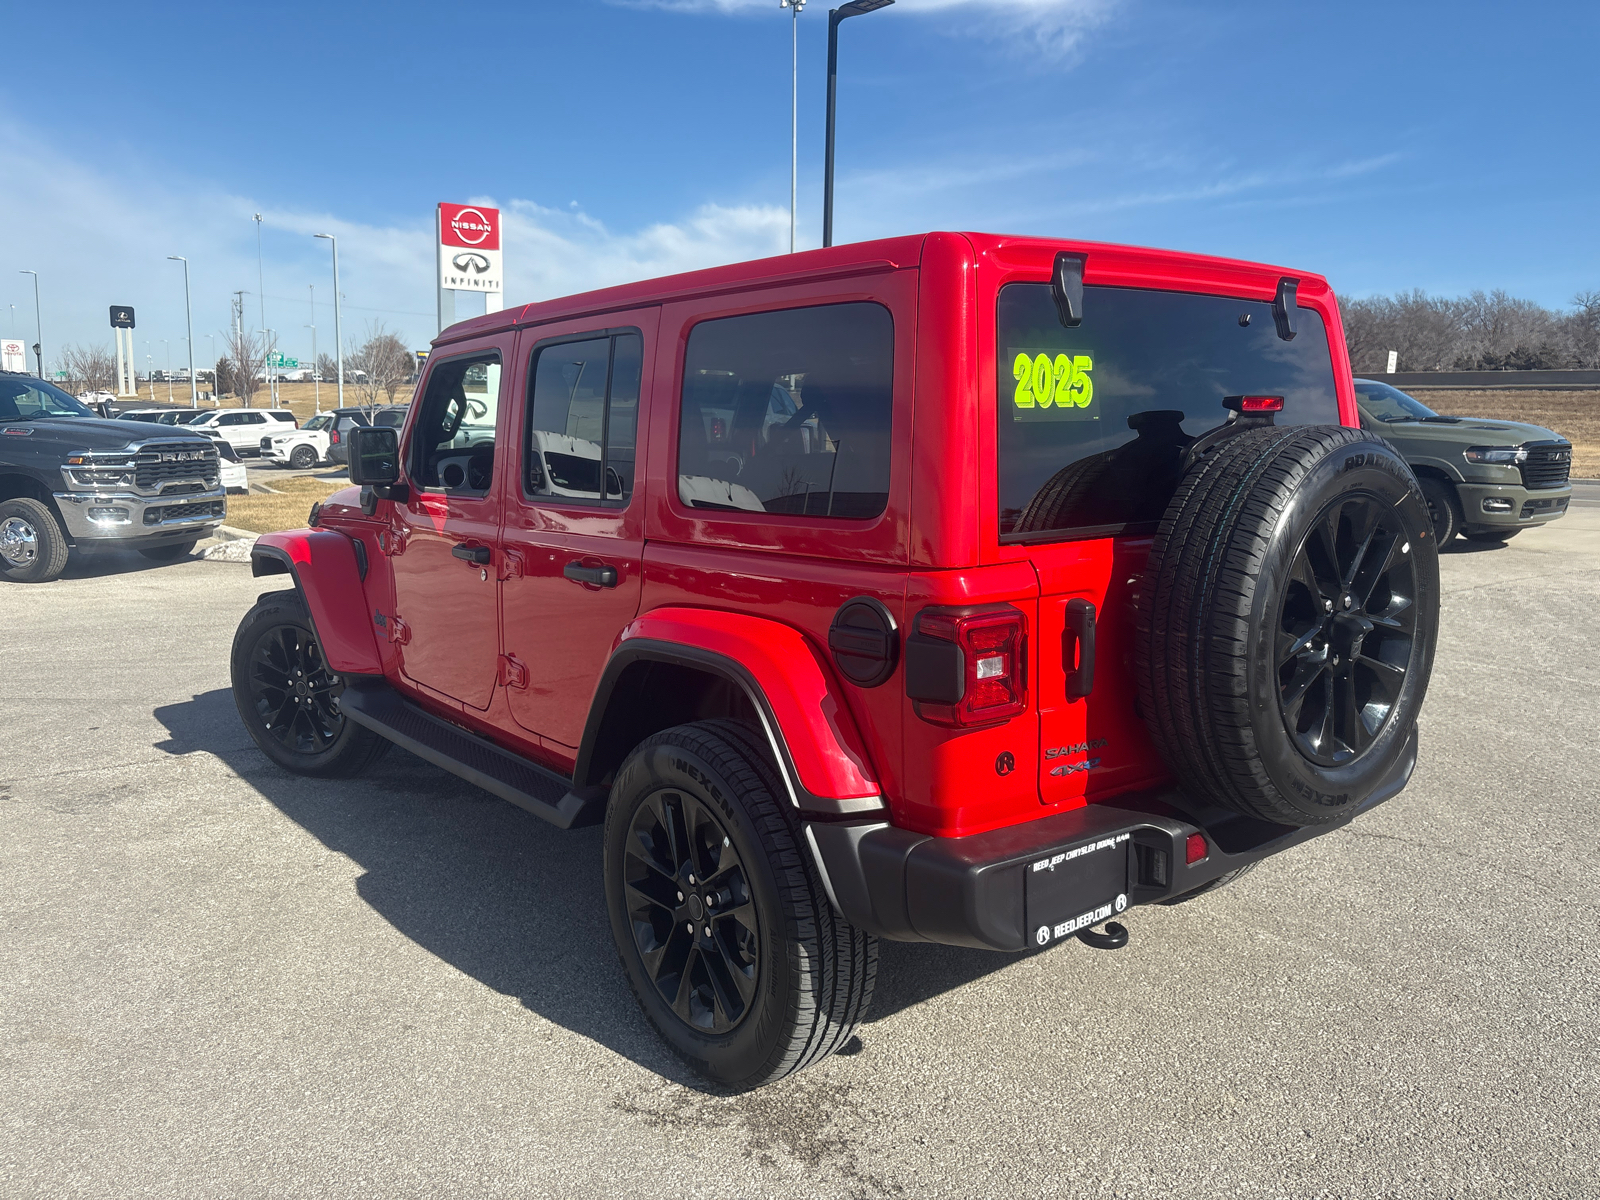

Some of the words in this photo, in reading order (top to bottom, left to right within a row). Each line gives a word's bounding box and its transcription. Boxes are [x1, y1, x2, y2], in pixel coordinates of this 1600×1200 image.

[451, 220, 491, 232] NISSAN
[444, 276, 499, 289] INFINITI
[1013, 353, 1093, 409] 2025
[162, 451, 205, 462] RAM
[1045, 738, 1109, 760] SAHARA
[675, 758, 735, 820] NEXEN
[1291, 776, 1349, 807] NEXEN
[1033, 858, 1049, 872] REED
[1049, 853, 1065, 867] JEEP
[1065, 843, 1096, 860] CHRYSLER
[1054, 904, 1111, 939] REEDJEEP.COM
